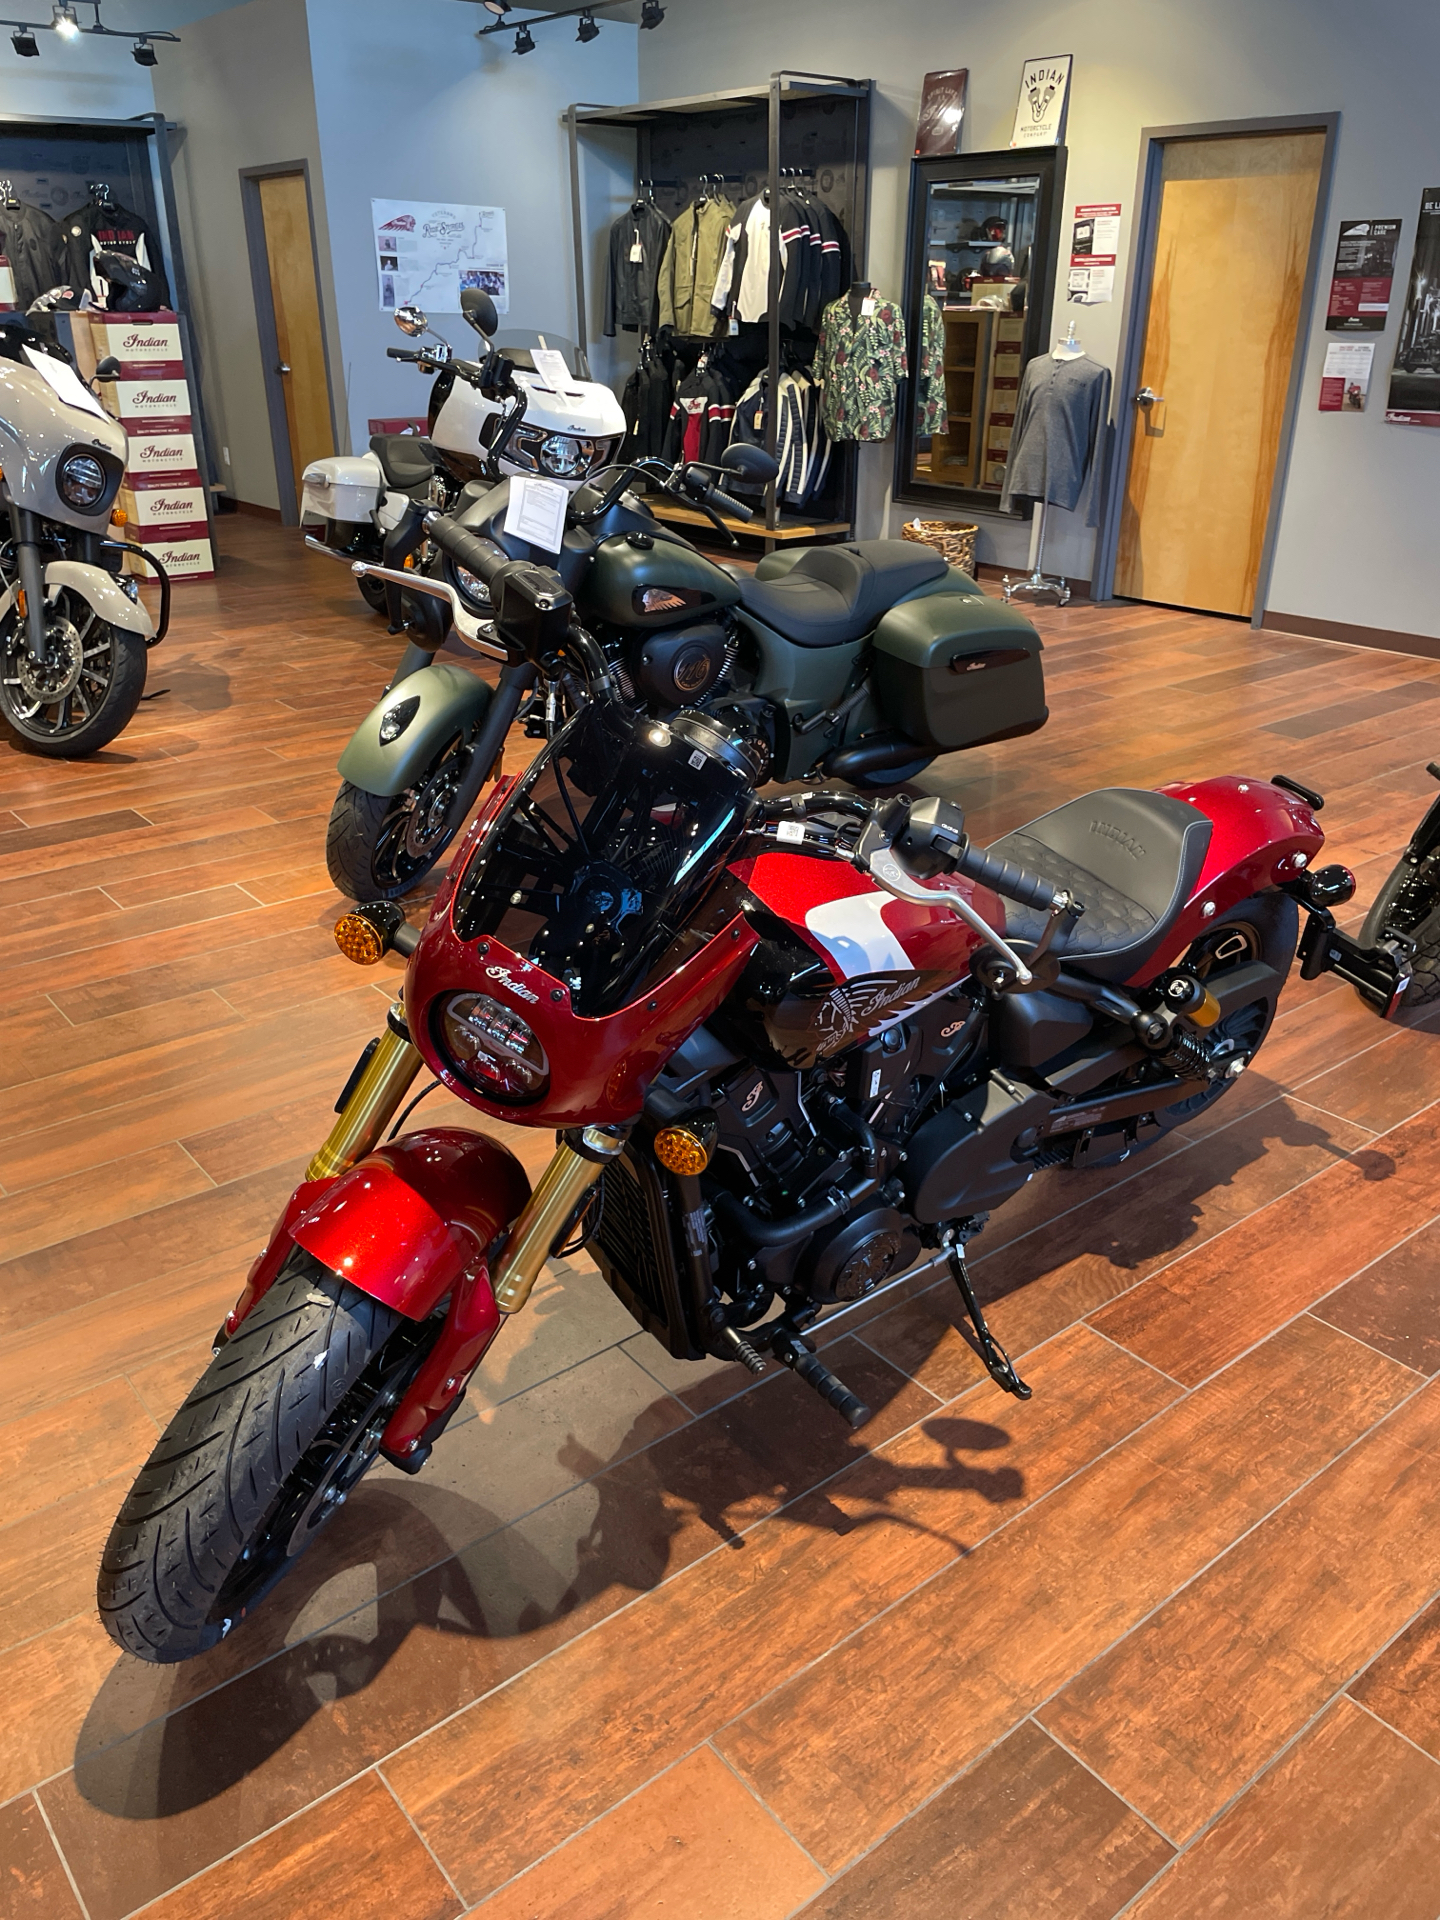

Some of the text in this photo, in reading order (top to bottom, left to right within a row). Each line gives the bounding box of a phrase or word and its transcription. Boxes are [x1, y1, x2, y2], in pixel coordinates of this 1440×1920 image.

[1025, 68, 1064, 89] INDIAN
[1020, 123, 1052, 132] MOTORCYCLE
[123, 333, 169, 348] Indian
[132, 390, 177, 404] Indian
[140, 445, 183, 459] Indian
[150, 498, 193, 512] Indian
[159, 550, 201, 564] Indian
[1089, 820, 1147, 860] INDIAN
[485, 965, 540, 1004] Indian
[860, 976, 921, 1017] Indian
